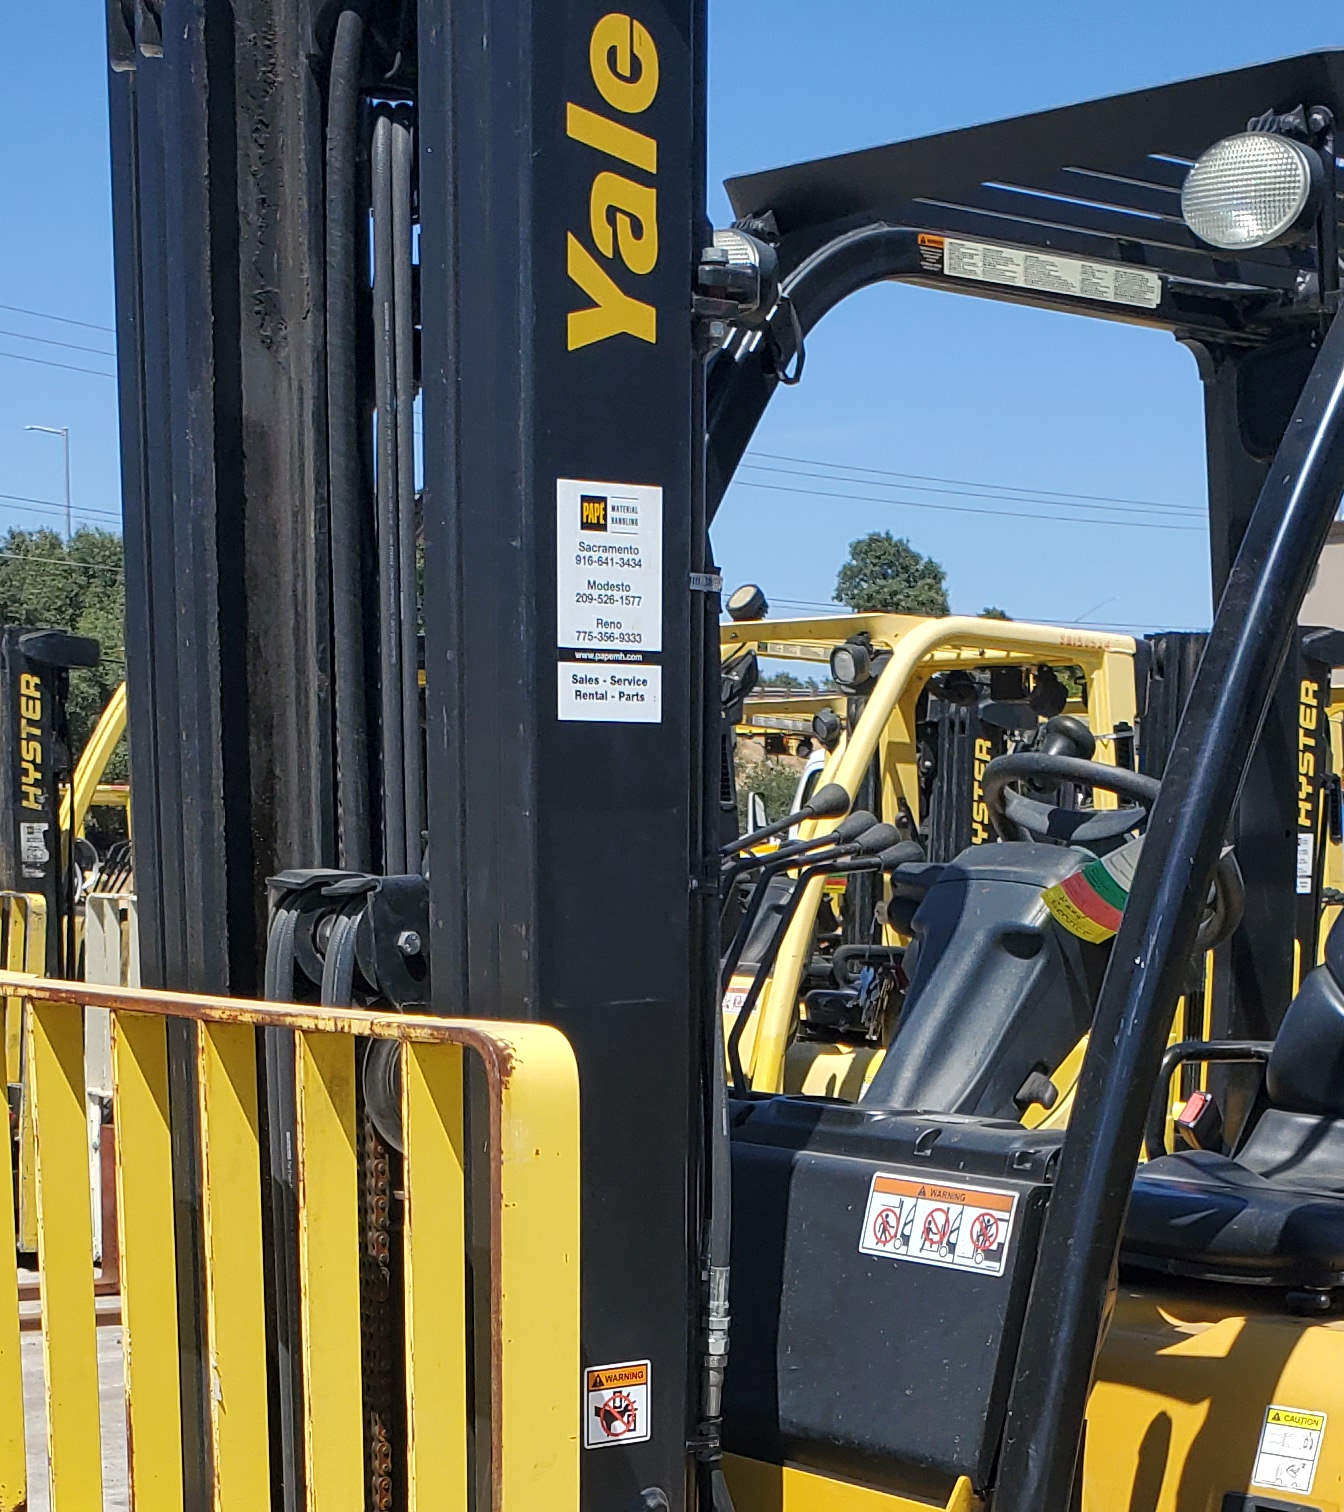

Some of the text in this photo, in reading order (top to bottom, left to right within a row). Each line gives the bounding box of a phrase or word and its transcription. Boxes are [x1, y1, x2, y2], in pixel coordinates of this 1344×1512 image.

[566, 12, 659, 351] Yale
[611, 505, 639, 514] MATERIAL
[611, 516, 639, 526] HANDLING
[578, 541, 640, 556] Sacramento
[575, 555, 642, 568] 916-641-3434
[587, 579, 631, 592] Modesto
[575, 592, 642, 606] 209-526-1577
[596, 618, 622, 629] Reno
[575, 630, 642, 643] 775-356-9333
[574, 651, 643, 661] www.papemh.com
[571, 674, 599, 685] Sales
[609, 675, 648, 687] Service
[575, 690, 607, 701] Rental
[619, 691, 645, 701] Parts
[21, 673, 43, 811] HYSTER
[1298, 680, 1319, 827] HYSTER
[971, 737, 992, 845] YSTER
[930, 1188, 966, 1202] WARNING
[605, 1371, 644, 1383] WARNING
[1284, 1414, 1319, 1427] CAUTION
